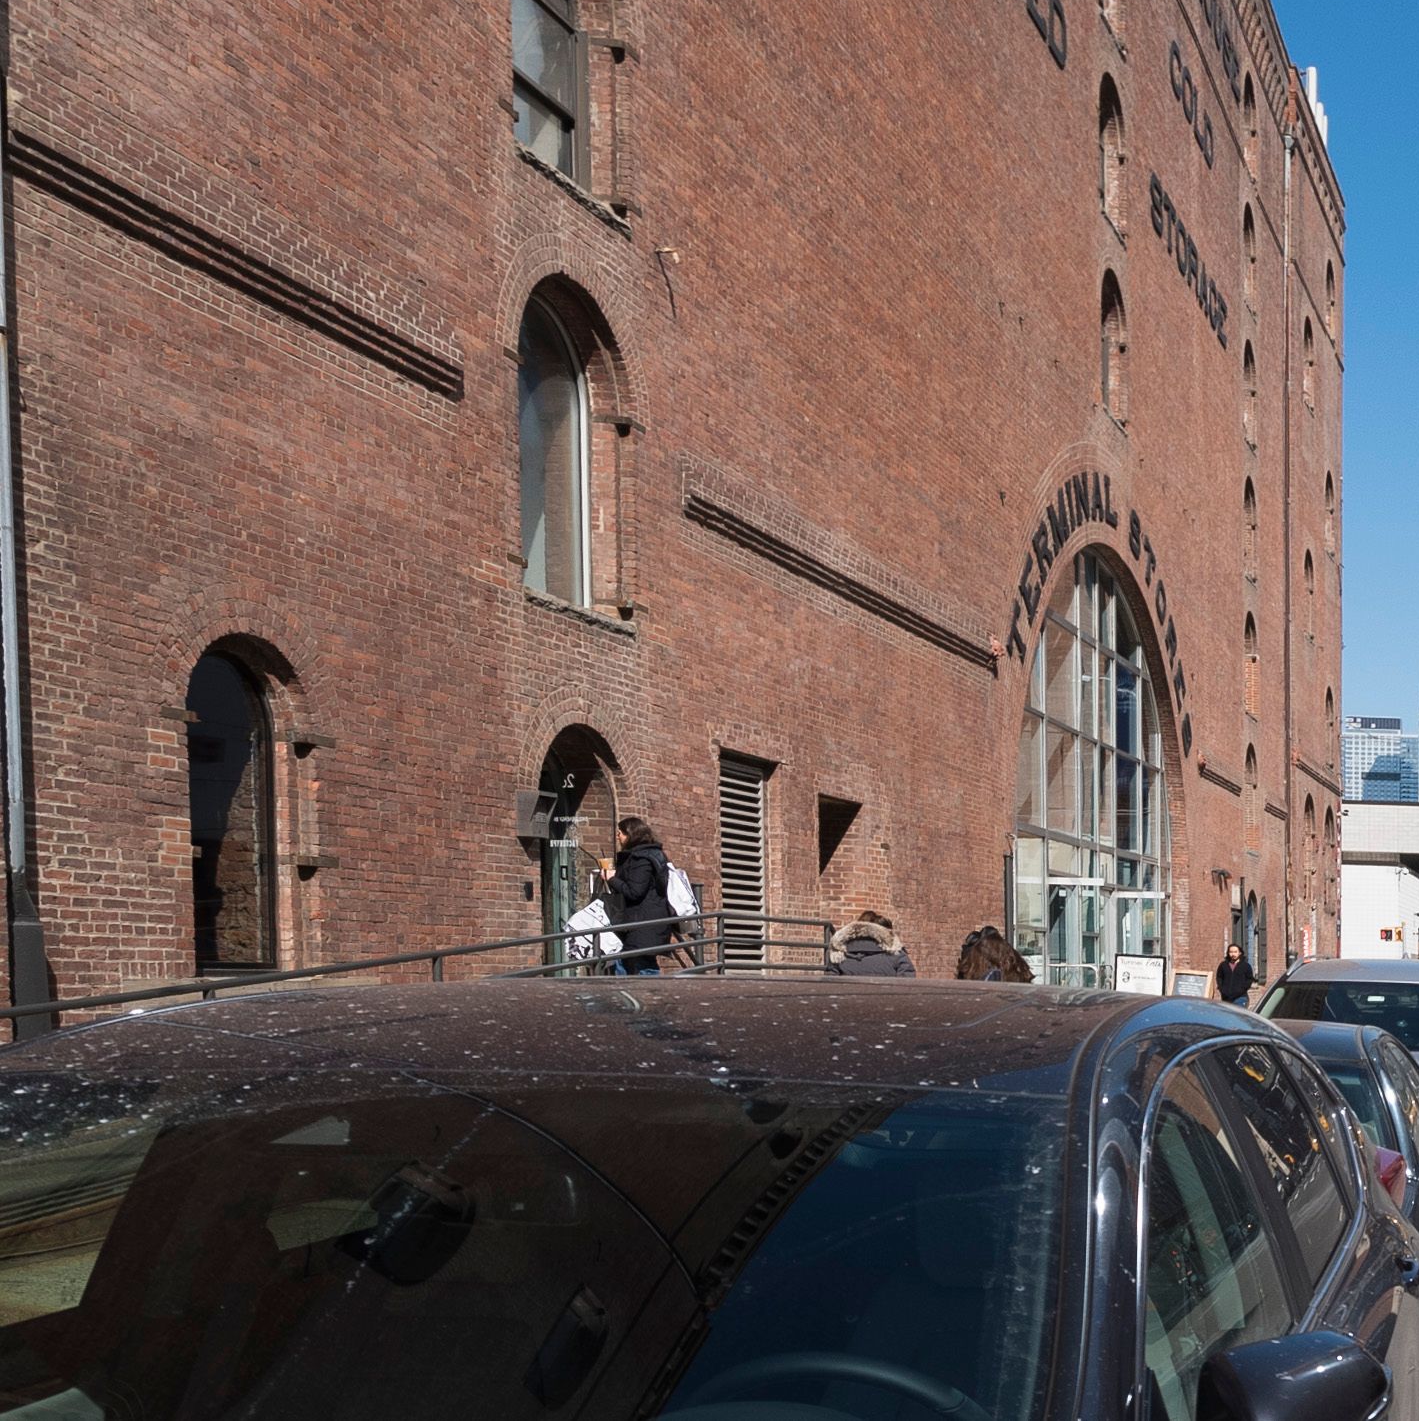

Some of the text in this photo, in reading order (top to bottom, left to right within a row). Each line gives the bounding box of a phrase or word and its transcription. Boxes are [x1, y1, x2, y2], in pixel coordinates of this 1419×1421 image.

[1170, 40, 1213, 169] COLD
[1150, 171, 1227, 350] STORAGE
[1006, 471, 1193, 759] TERMINAL STORES
